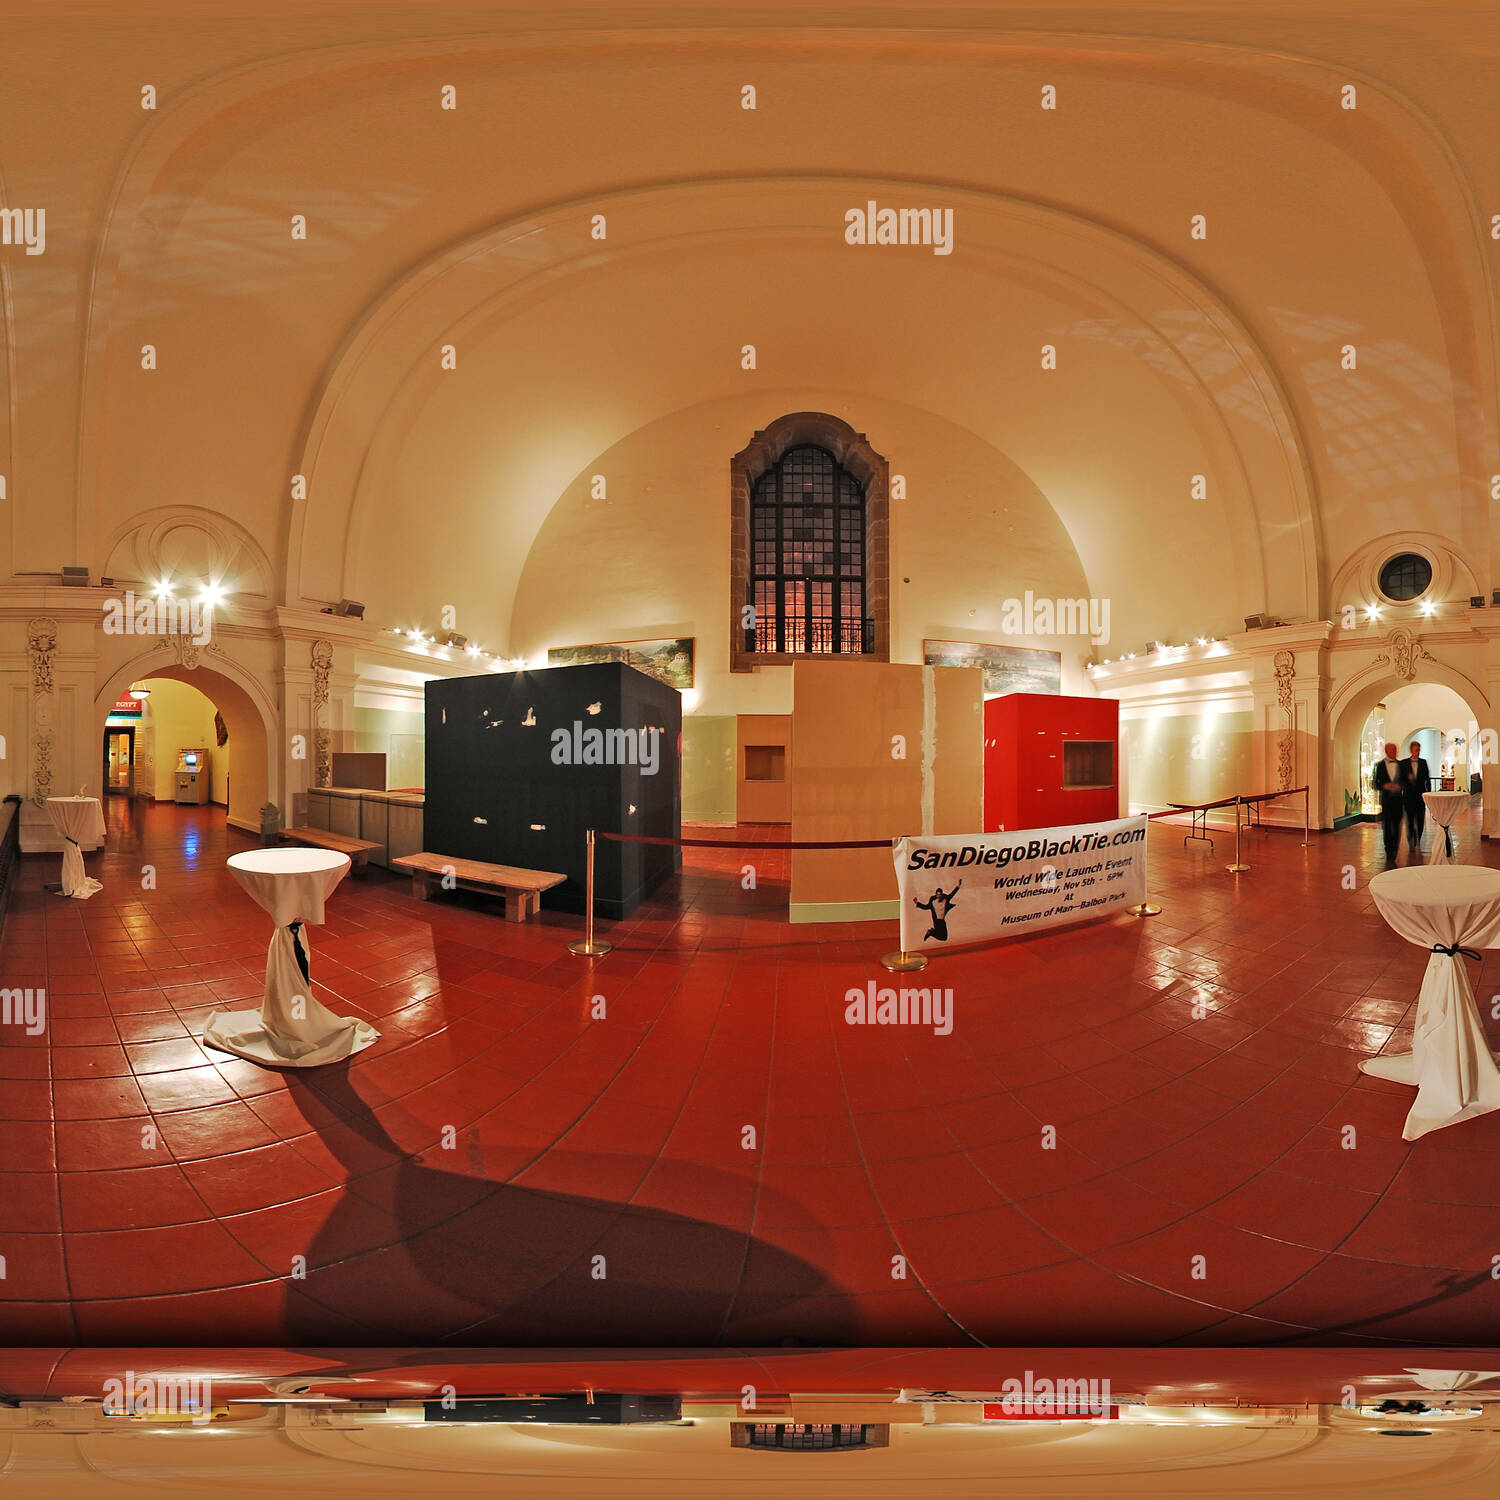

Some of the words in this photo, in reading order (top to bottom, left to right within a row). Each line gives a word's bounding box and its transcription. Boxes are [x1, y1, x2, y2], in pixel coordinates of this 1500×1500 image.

[907, 828, 1146, 870] SanDiegoBlackTie.com
[993, 873, 1032, 889] World
[1034, 869, 1064, 883] Wide
[1065, 861, 1103, 878] Launch
[1104, 856, 1133, 870] Event
[1005, 885, 1061, 901] Wednesday,
[1063, 880, 1081, 891] Nov
[1081, 876, 1096, 887] 5th
[1000, 910, 1042, 925] Museum
[1043, 906, 1056, 918] of
[1108, 891, 1127, 902] Park
[1063, 893, 1075, 902] At
